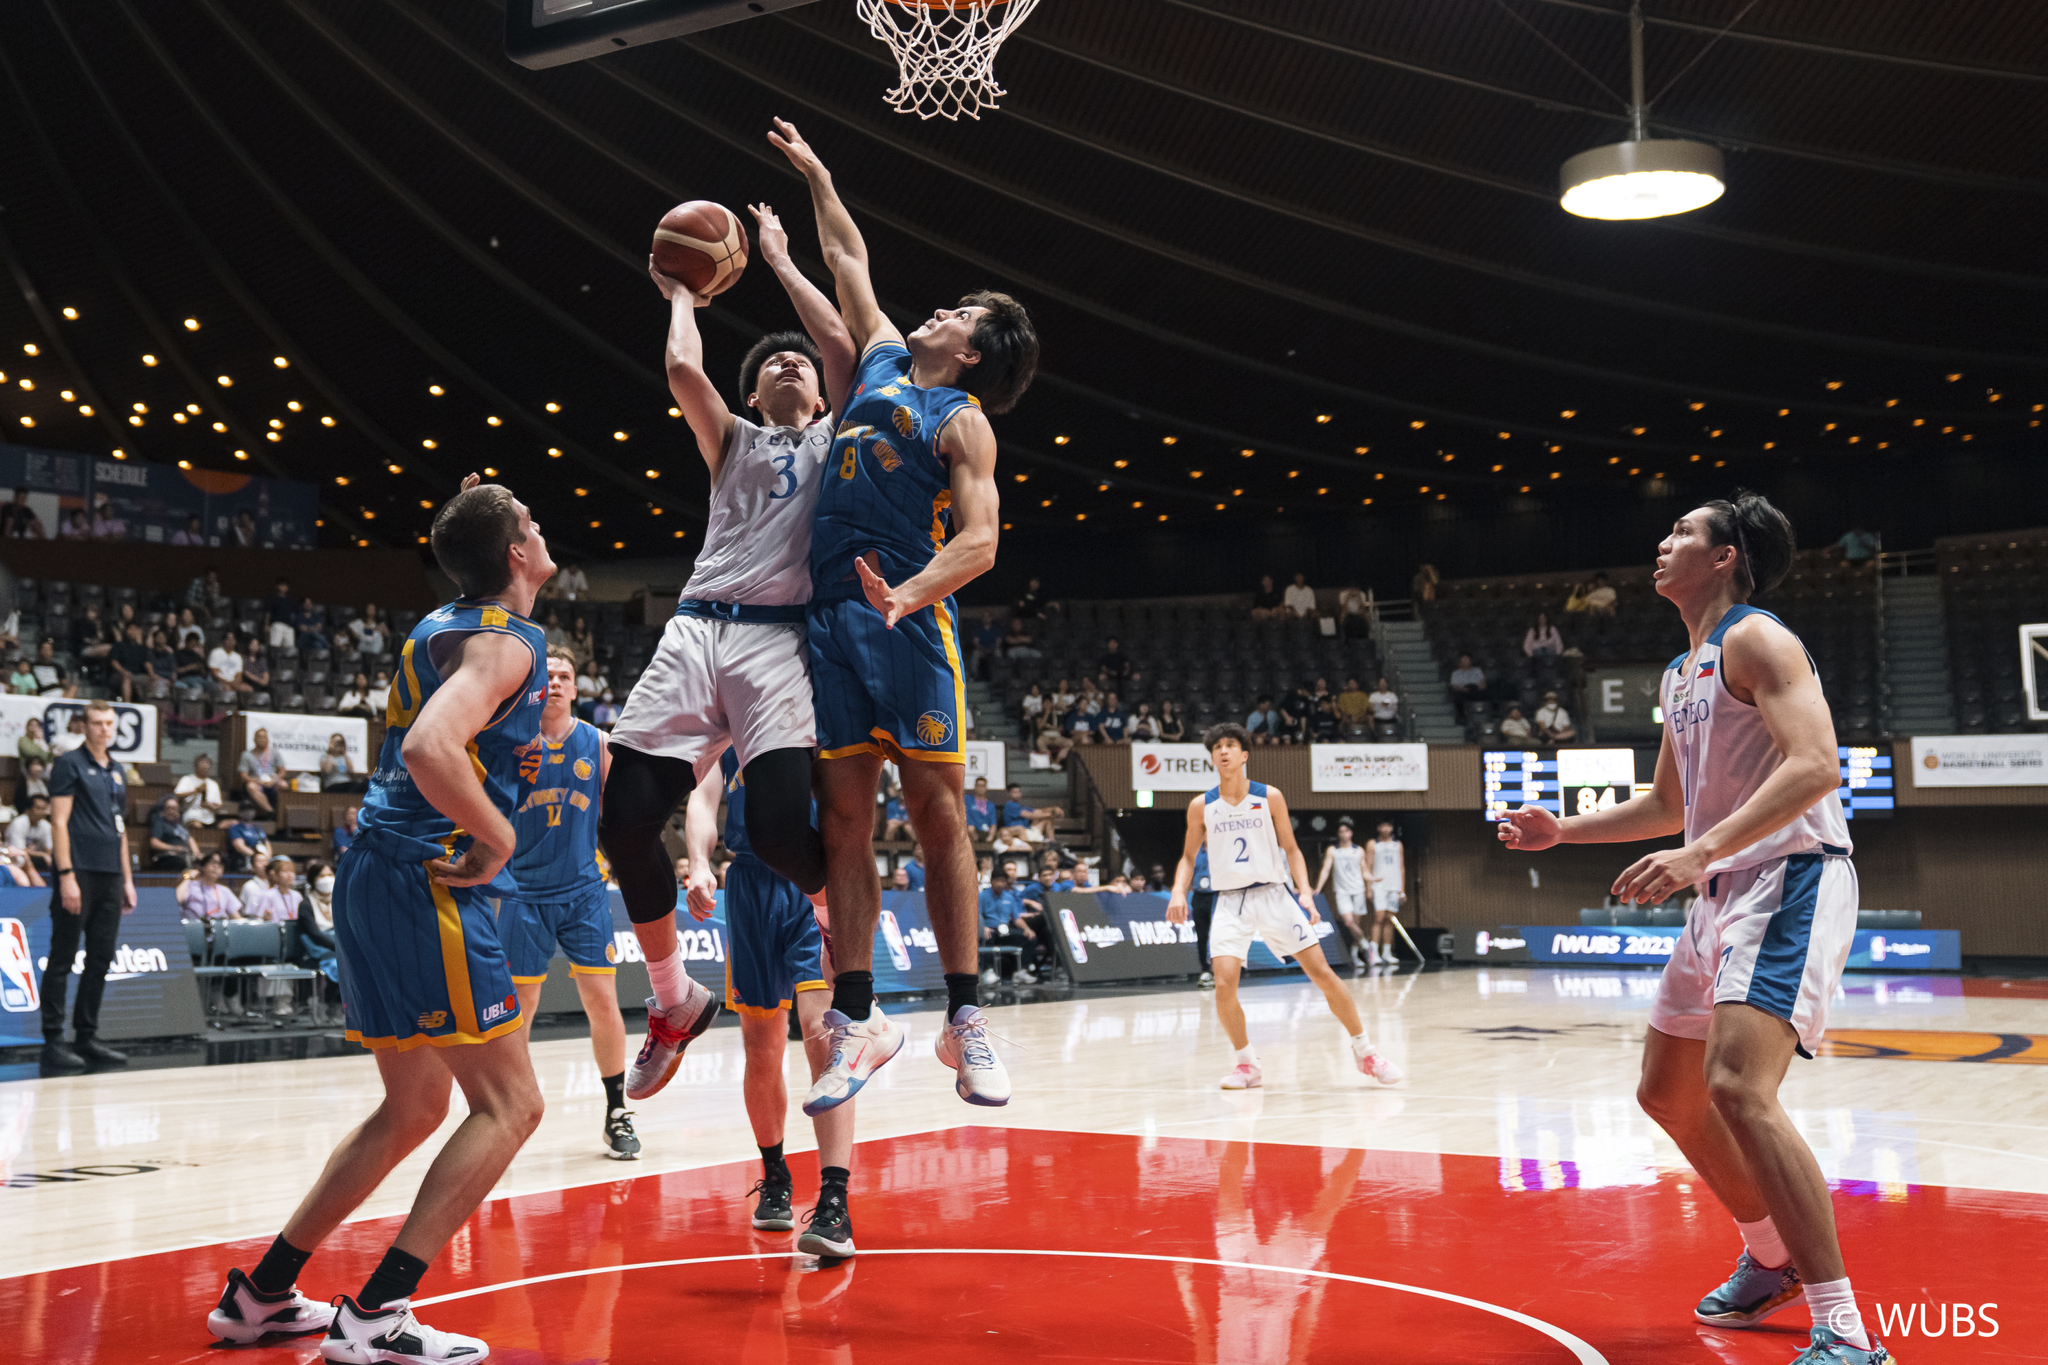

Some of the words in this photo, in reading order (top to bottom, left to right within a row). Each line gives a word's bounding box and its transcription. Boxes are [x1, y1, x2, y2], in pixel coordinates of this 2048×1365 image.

[769, 454, 798, 499] 3
[839, 446, 856, 480] 8
[1602, 679, 1625, 713] E
[777, 697, 799, 731] 3
[1164, 758, 1215, 772] TREN
[1577, 786, 1617, 816] 84
[1214, 818, 1263, 833] ATENEO
[1233, 837, 1250, 863] 2
[1293, 924, 1308, 941] 2
[483, 1001, 508, 1021] UBL
